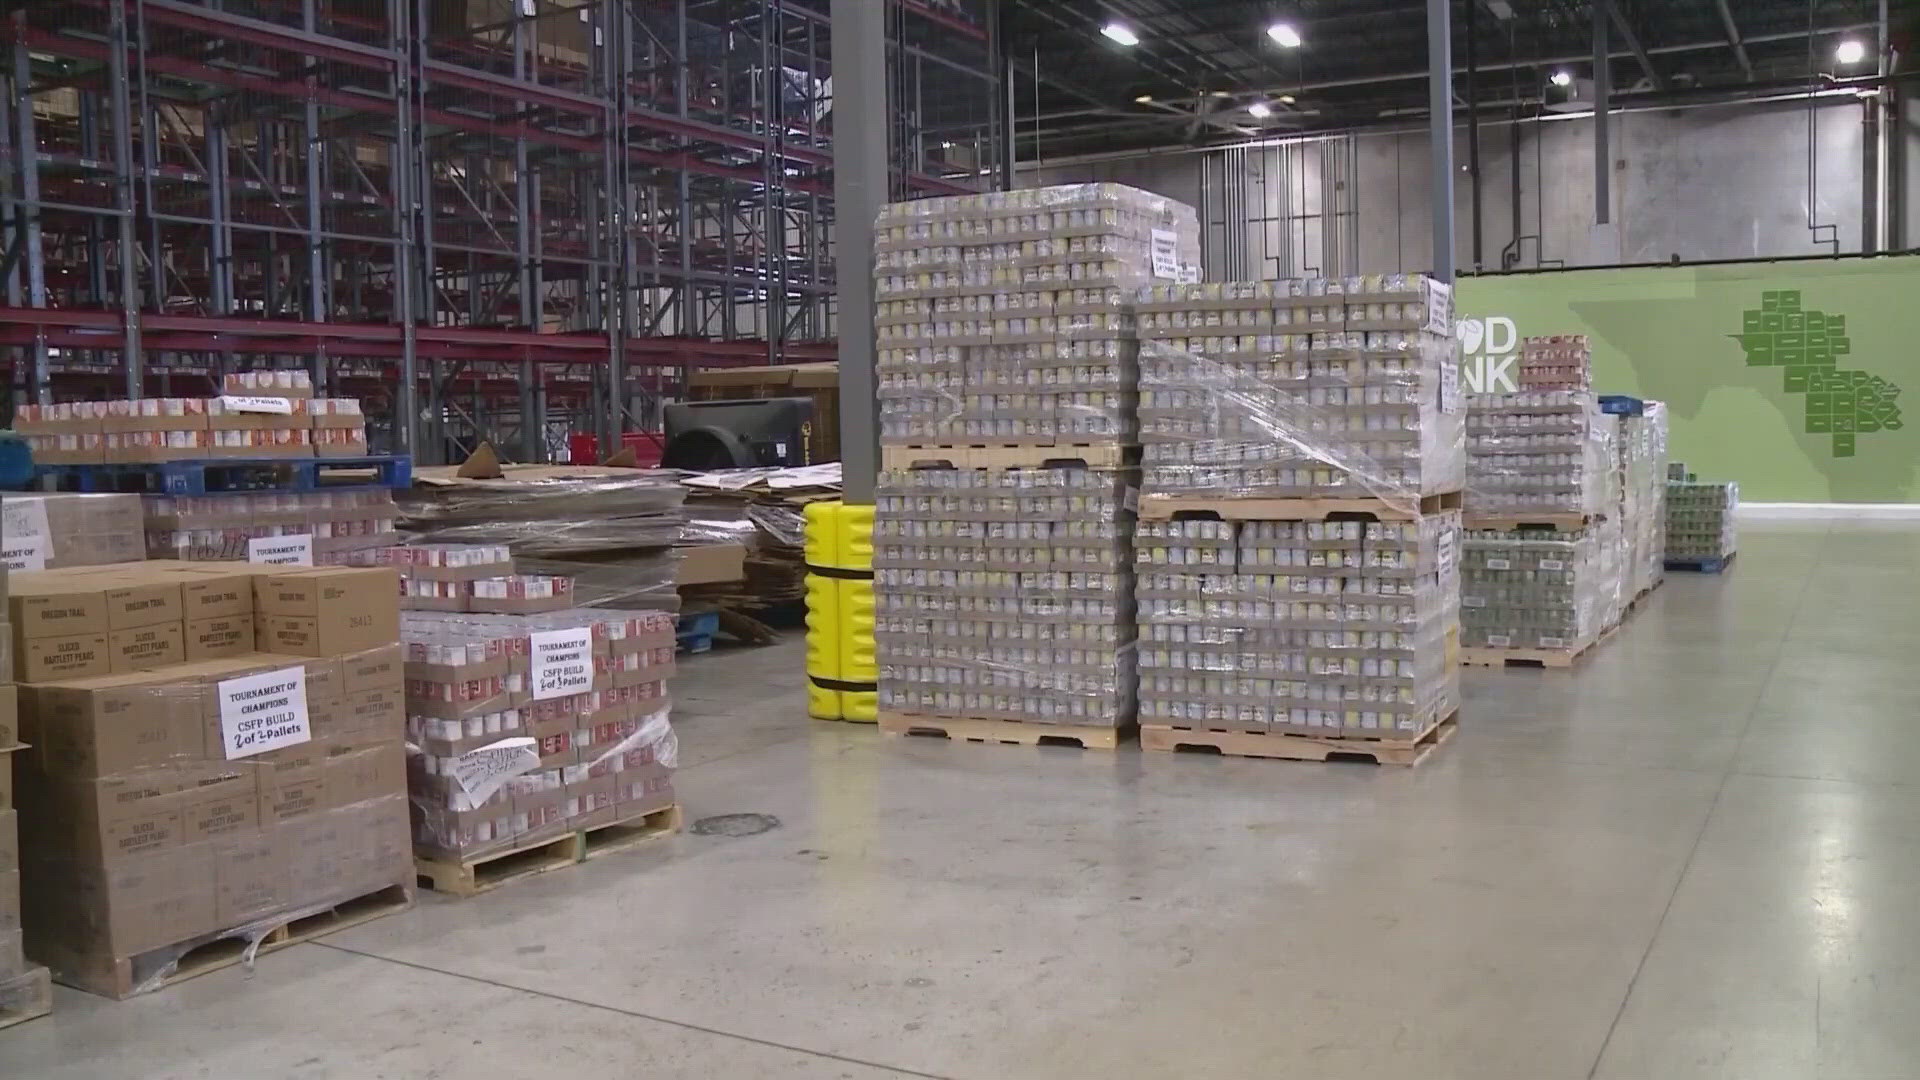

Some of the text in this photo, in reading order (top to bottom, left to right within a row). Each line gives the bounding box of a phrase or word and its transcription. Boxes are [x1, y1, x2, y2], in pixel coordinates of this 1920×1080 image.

[256, 546, 297, 556] TOURNAMENT
[125, 598, 166, 612] OREGON TRAIL
[42, 608, 85, 620] OREGON TRAIL
[135, 632, 156, 642] SLICED
[58, 642, 80, 652] SLICED
[122, 640, 169, 655] BARTLETT PEARS
[538, 640, 587, 652] TOURNAMENT OF
[44, 651, 94, 665] BARTLETT PEARS
[546, 652, 580, 663] CHAMPIONS
[543, 666, 584, 678] CSFP BUILD
[547, 679, 555, 688] of
[564, 676, 587, 686] Pallets
[230, 682, 298, 702] TOURNAMENT OF
[241, 697, 289, 714] CHAMPIONS
[238, 718, 264, 732] CSFP
[266, 712, 295, 726] BUILD
[234, 734, 244, 750] 2
[244, 732, 255, 744] of
[266, 724, 301, 740] Pallets
